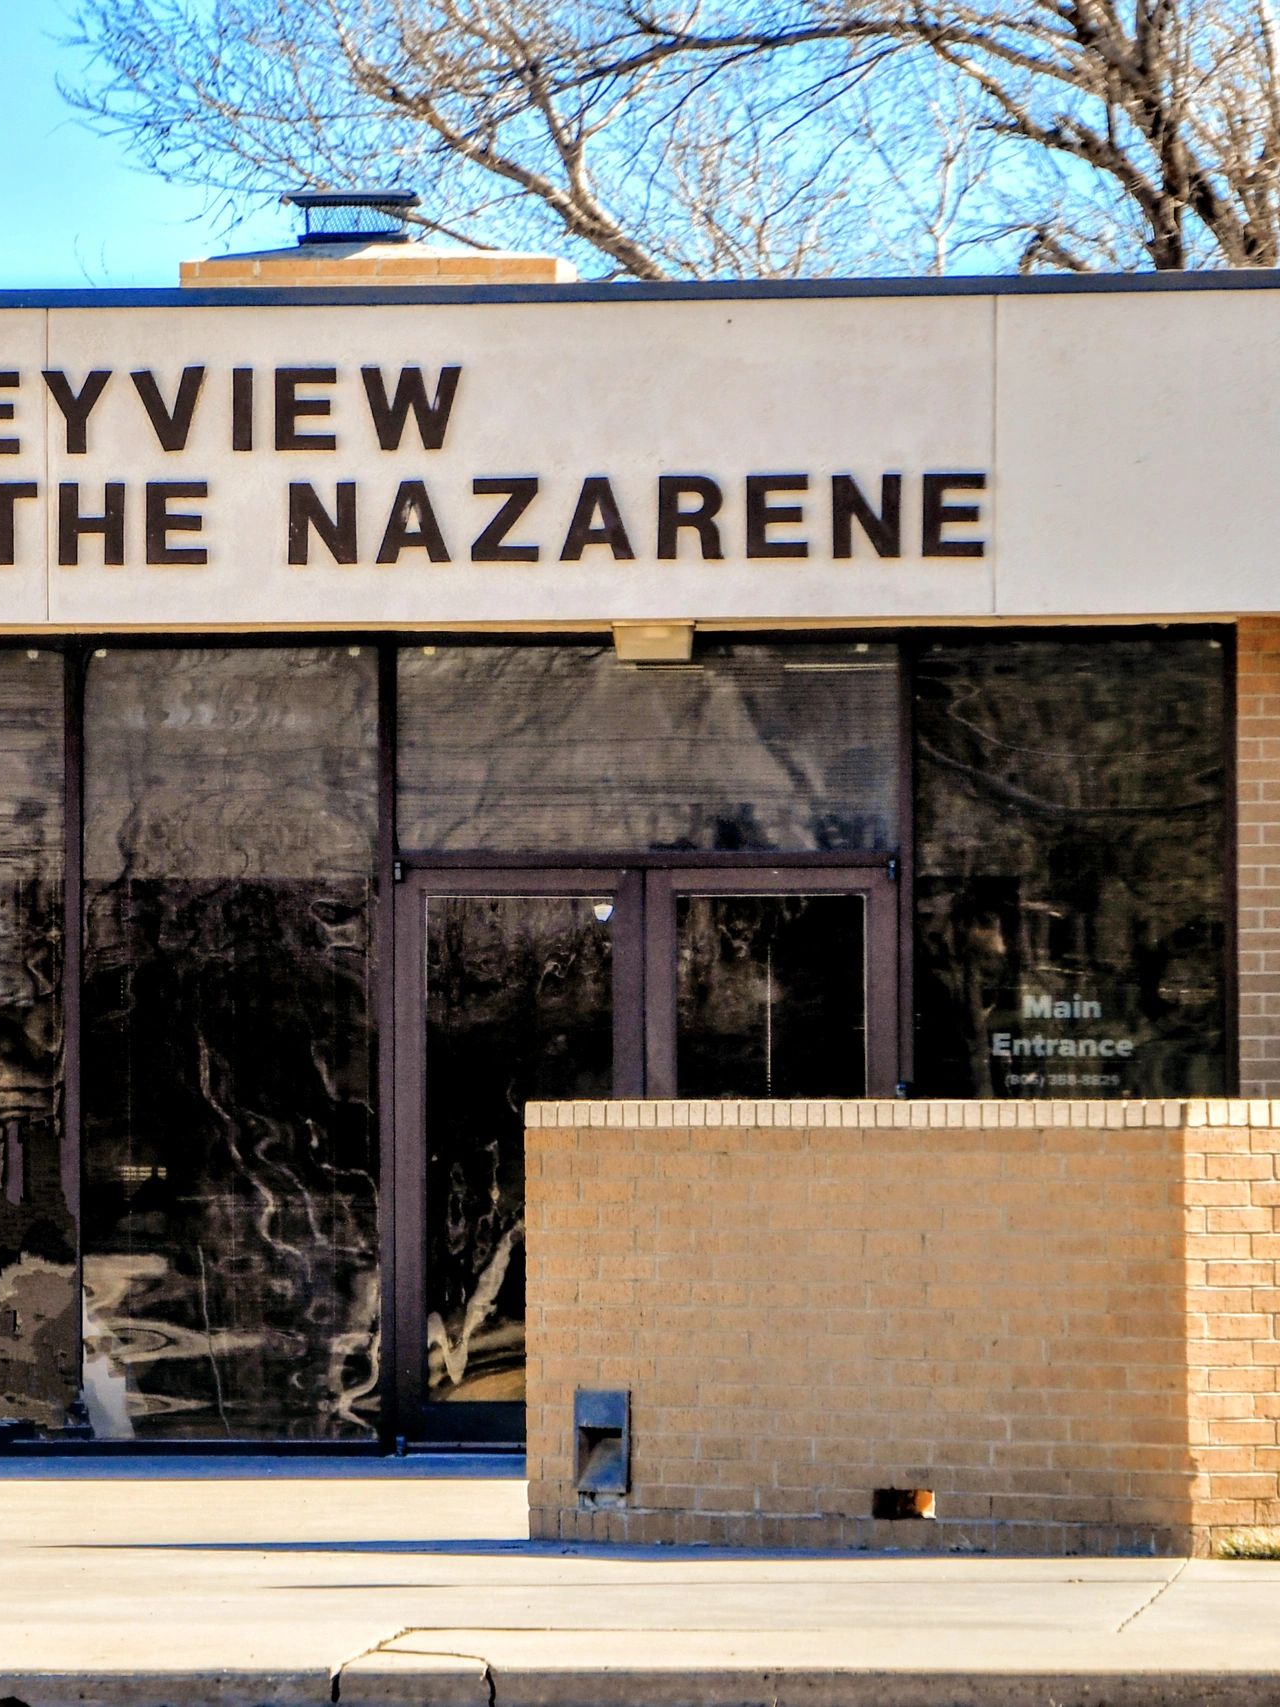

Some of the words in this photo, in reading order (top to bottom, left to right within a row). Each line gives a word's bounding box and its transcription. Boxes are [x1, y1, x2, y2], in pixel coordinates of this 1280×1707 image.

[287, 472, 987, 566] NAZARENE
[1022, 993, 1102, 1019] Main
[992, 1032, 1134, 1057] Entrance
